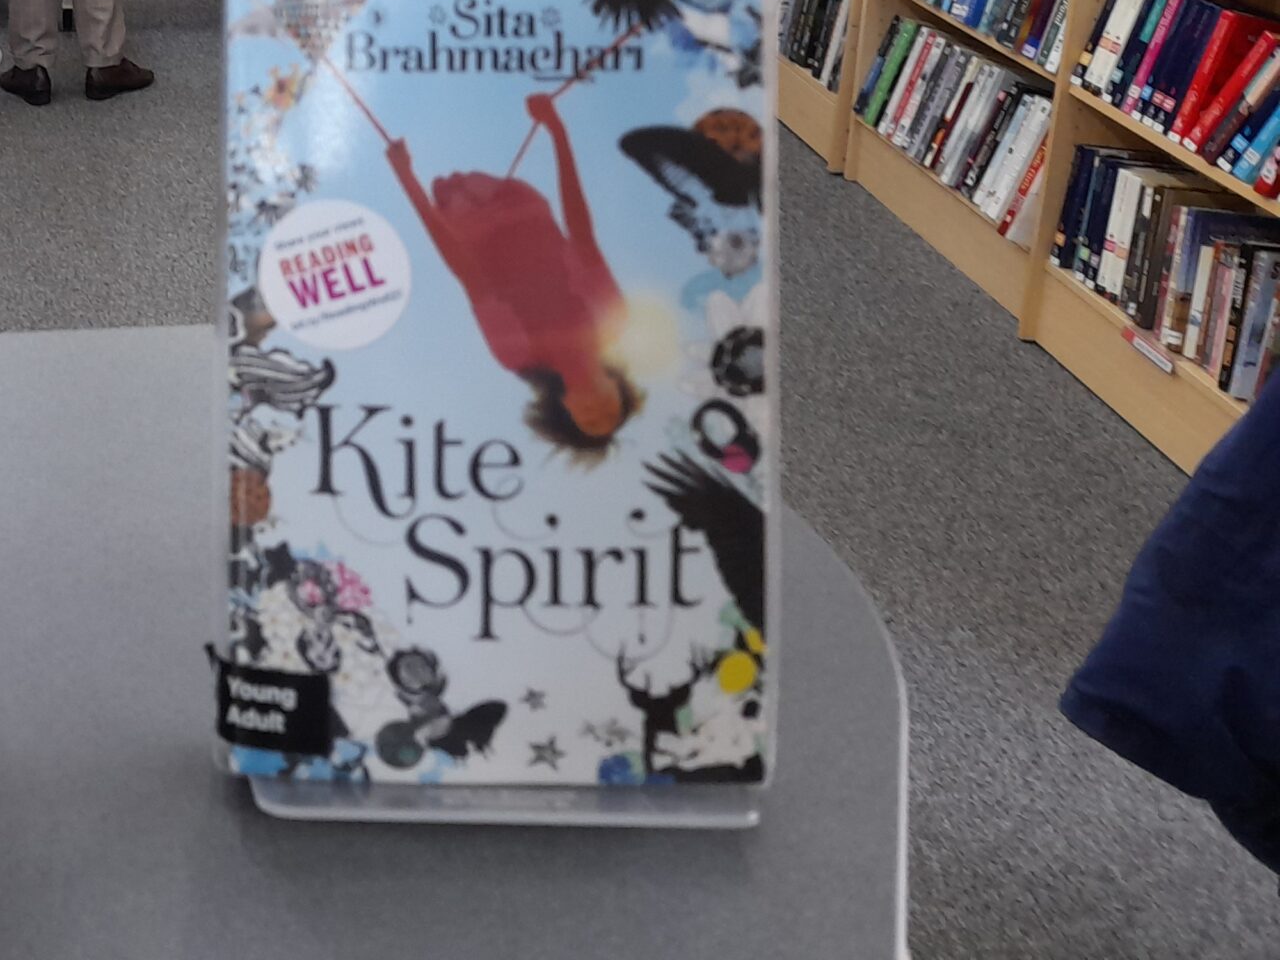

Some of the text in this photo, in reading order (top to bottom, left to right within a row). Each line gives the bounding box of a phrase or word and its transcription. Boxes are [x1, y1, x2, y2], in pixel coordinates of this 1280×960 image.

[343, 30, 645, 78] Brahmachari
[278, 232, 375, 279] READING
[289, 262, 387, 310] WELL
[311, 403, 523, 520] Kite
[405, 507, 704, 642] Spirit
[225, 676, 299, 711] Young
[225, 704, 288, 733] Adult
